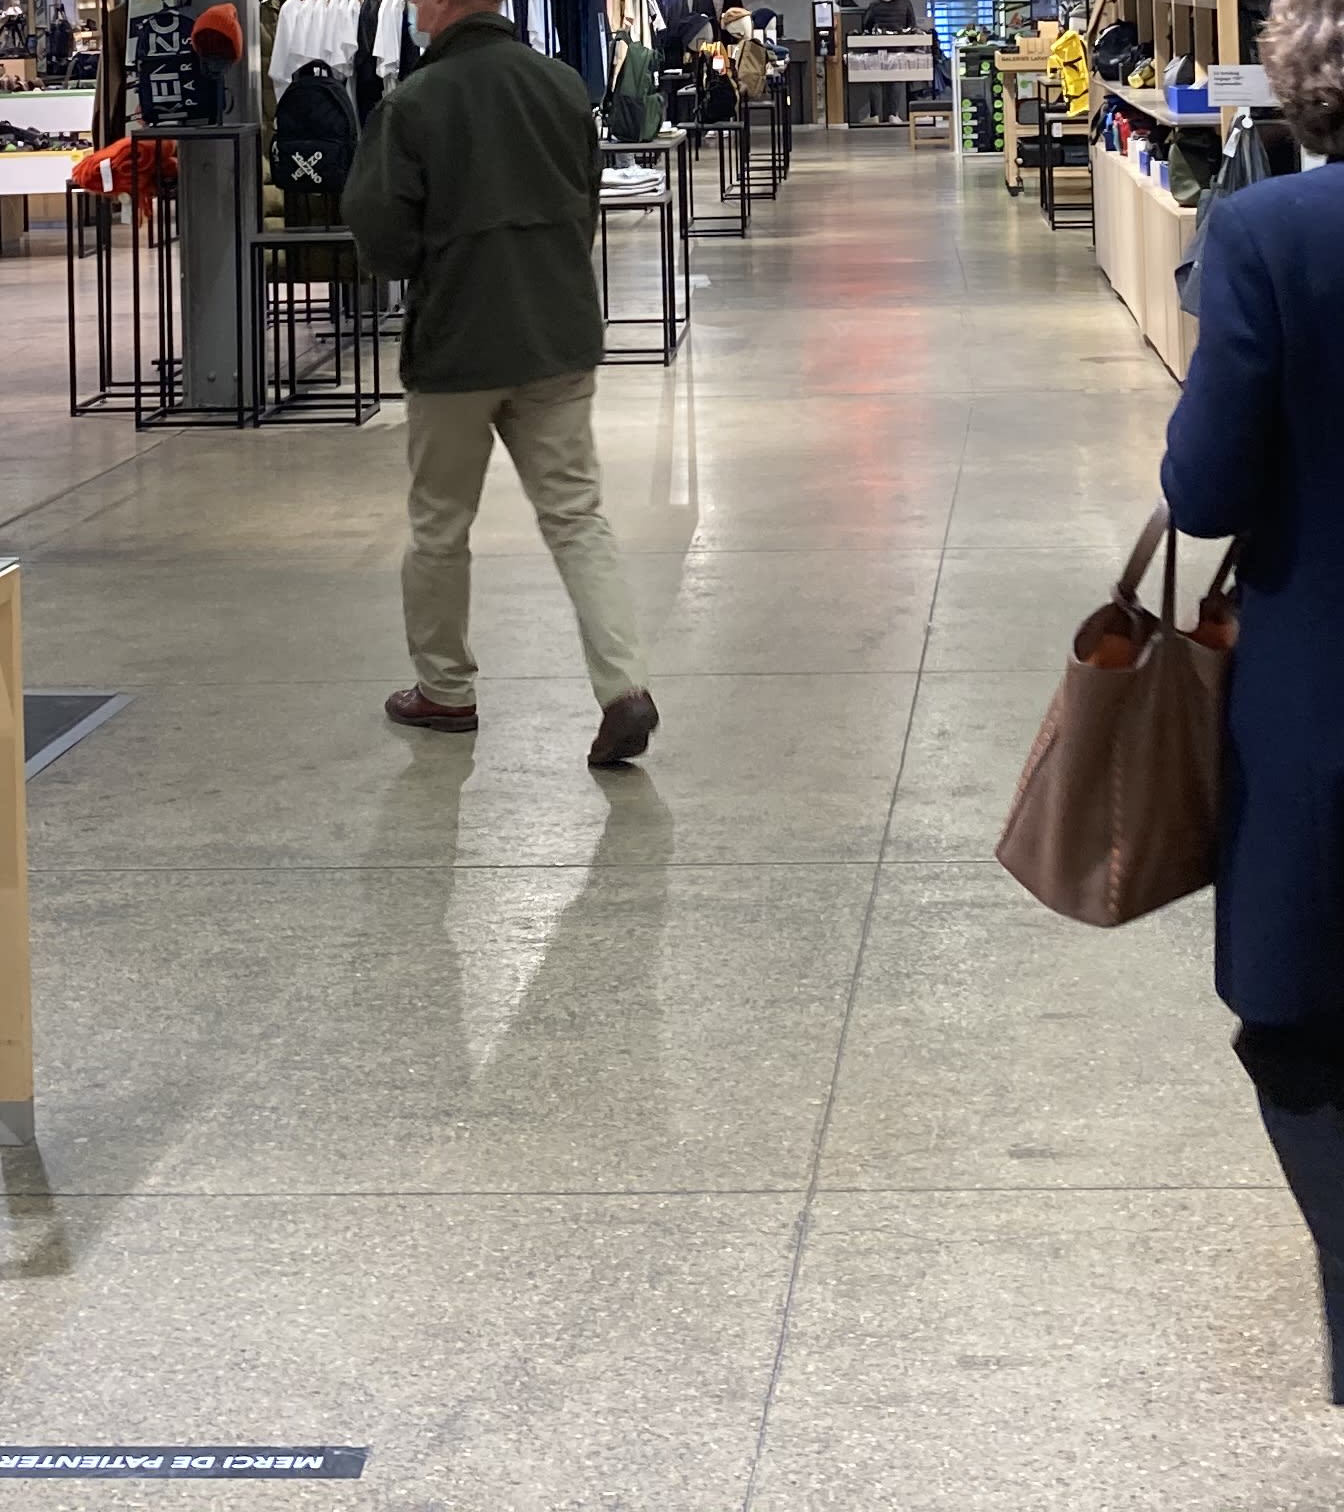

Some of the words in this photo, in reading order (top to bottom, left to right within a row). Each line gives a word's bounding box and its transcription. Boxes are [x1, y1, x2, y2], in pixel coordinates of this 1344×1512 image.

[0, 1454, 163, 1471] PATIENTER
[170, 1455, 216, 1471] DE
[223, 1455, 326, 1471] MERCI
